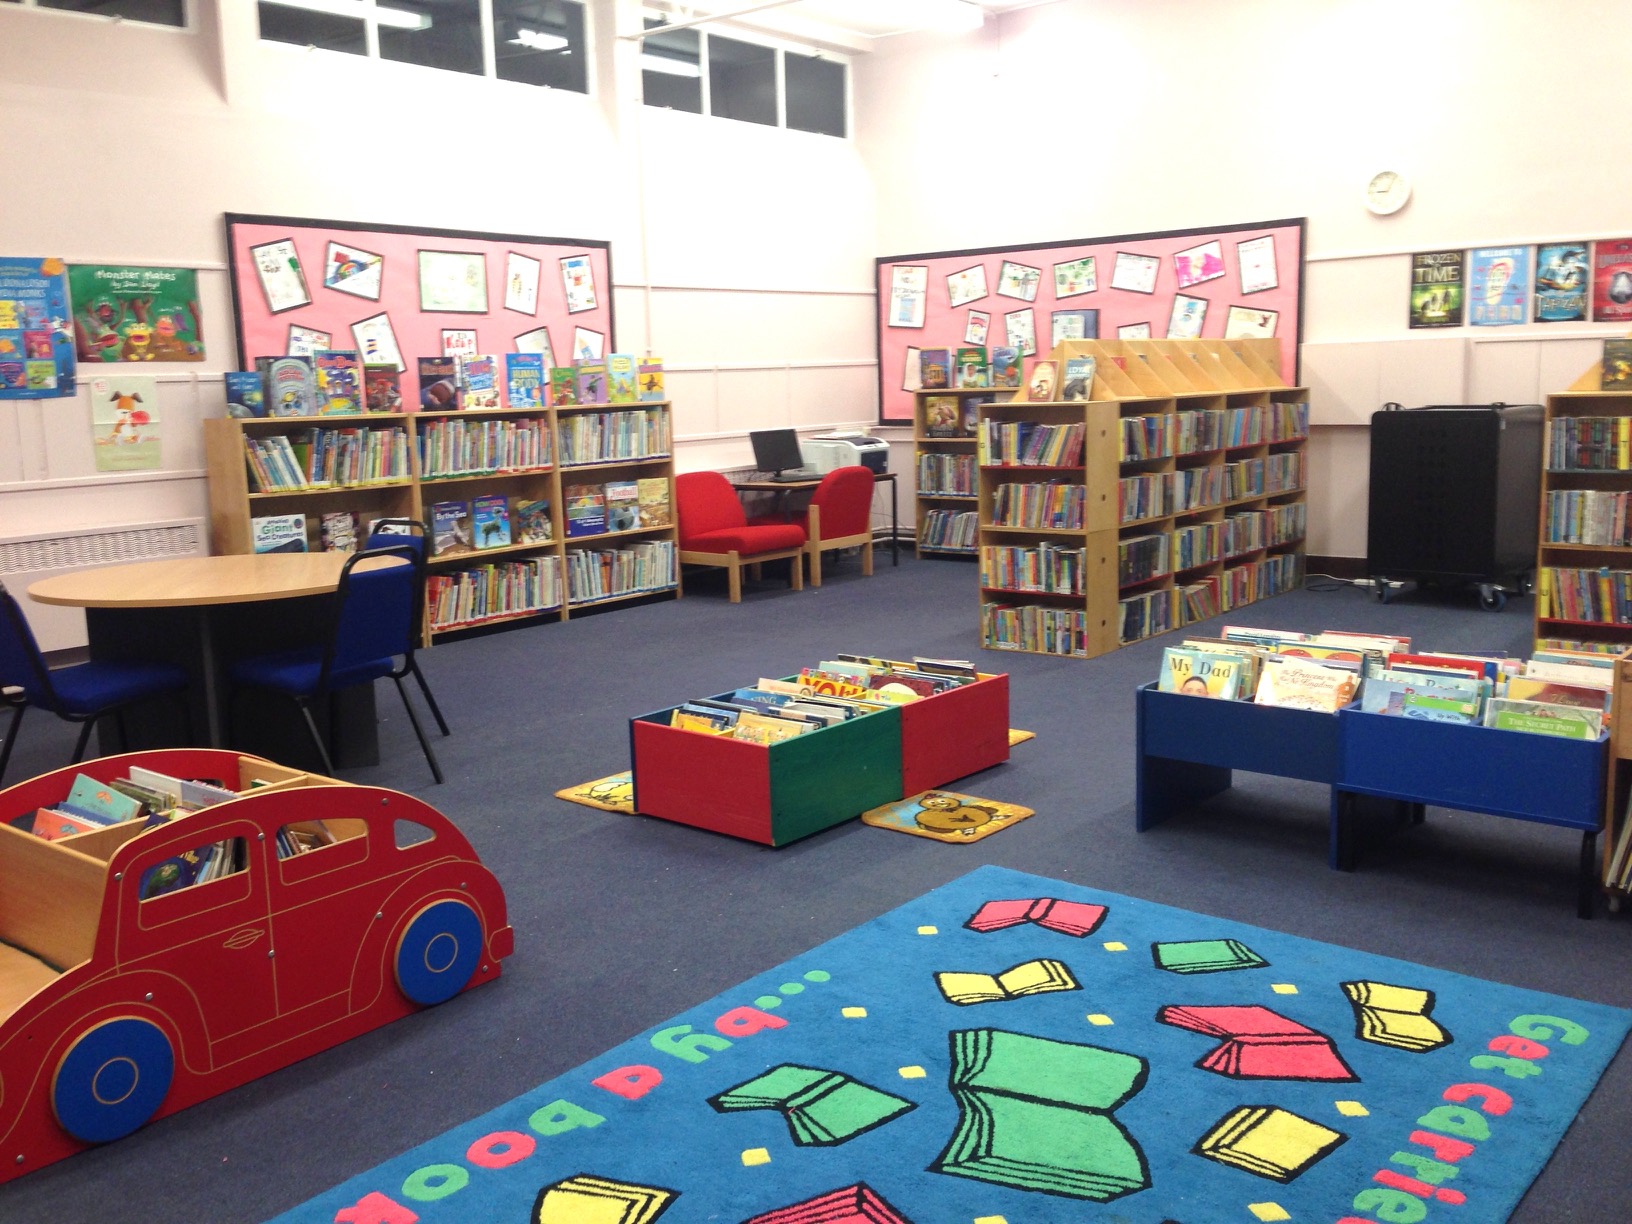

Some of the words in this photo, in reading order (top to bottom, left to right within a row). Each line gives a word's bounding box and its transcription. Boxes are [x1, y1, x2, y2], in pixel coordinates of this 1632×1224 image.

[1413, 266, 1461, 282] TIME
[262, 525, 293, 534] Giant
[1169, 657, 1193, 676] My
[1199, 661, 1232, 678] Dad
[1469, 1014, 1590, 1079] Get
